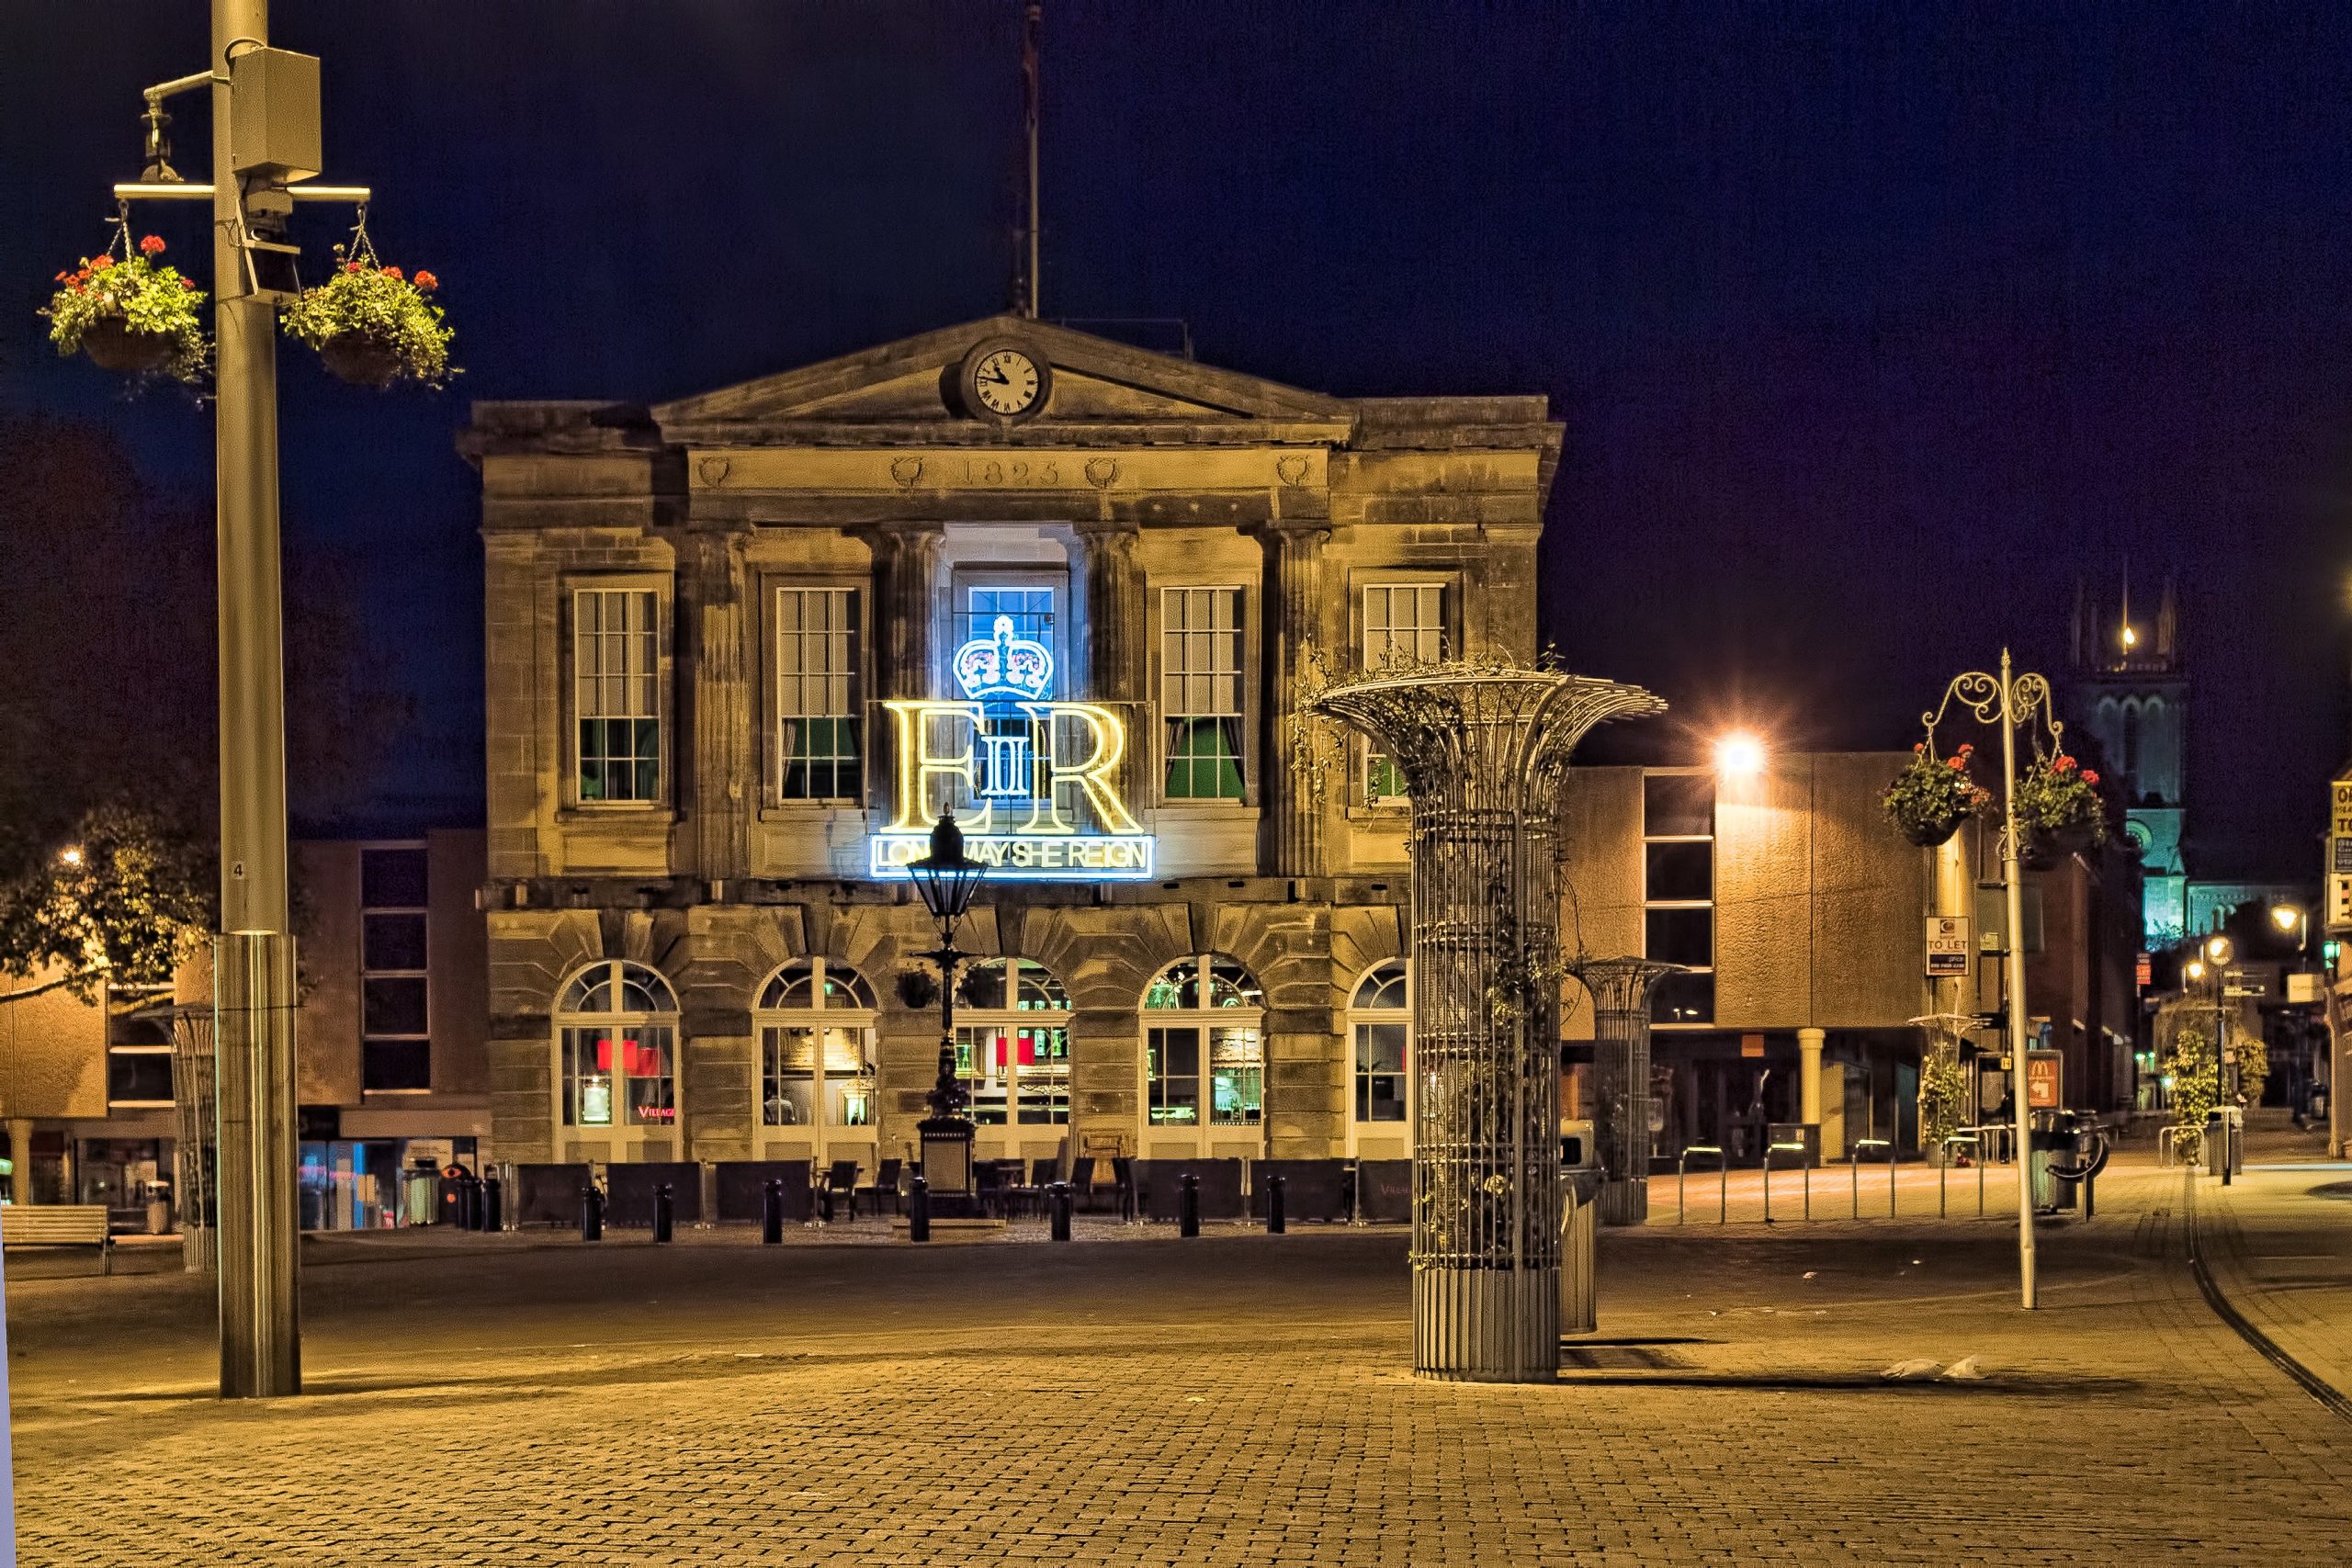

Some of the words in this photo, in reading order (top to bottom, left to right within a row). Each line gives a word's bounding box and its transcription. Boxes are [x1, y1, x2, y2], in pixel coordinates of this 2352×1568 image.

[967, 460, 1058, 485] 1825
[877, 840, 931, 867] LON
[1011, 841, 1062, 867] SHE
[1068, 841, 1147, 867] REIGN
[233, 863, 243, 875] 4
[1928, 940, 1942, 949] TO
[1948, 940, 1966, 949] LET
